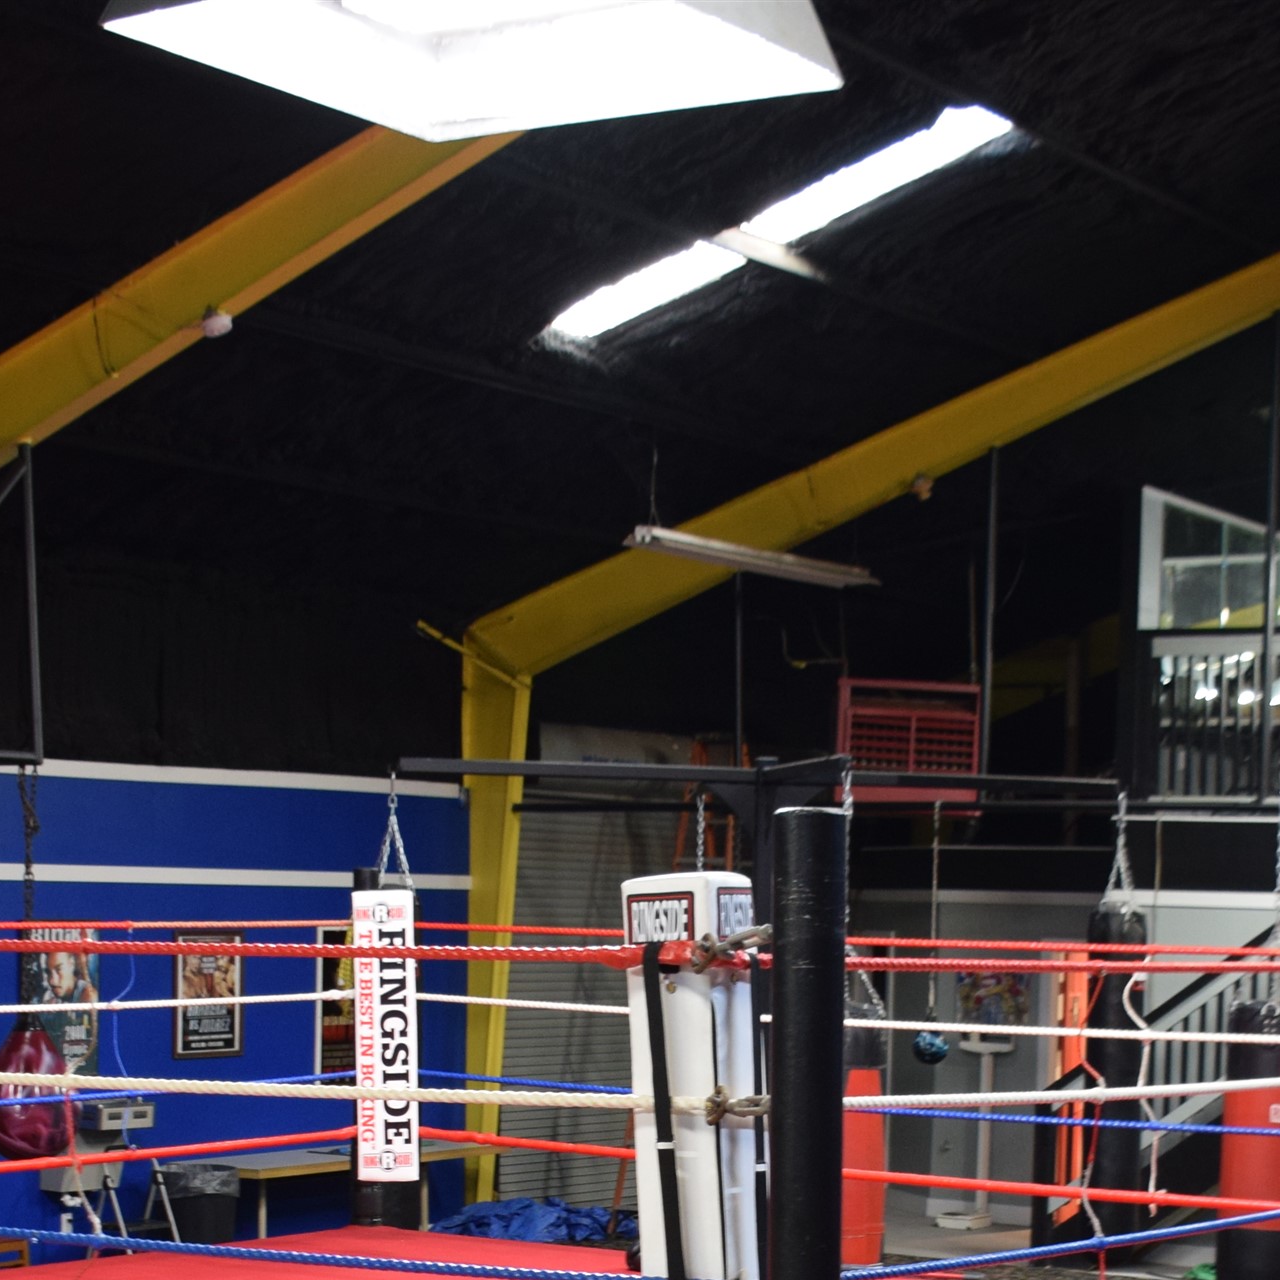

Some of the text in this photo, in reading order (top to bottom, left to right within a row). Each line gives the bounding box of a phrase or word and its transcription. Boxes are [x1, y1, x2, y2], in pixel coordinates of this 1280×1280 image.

[630, 899, 689, 943] RINGSIDE
[358, 930, 373, 973] TE
[359, 978, 375, 1030] BEST
[360, 1034, 375, 1058] IN
[378, 927, 412, 1145] RINGSIDE
